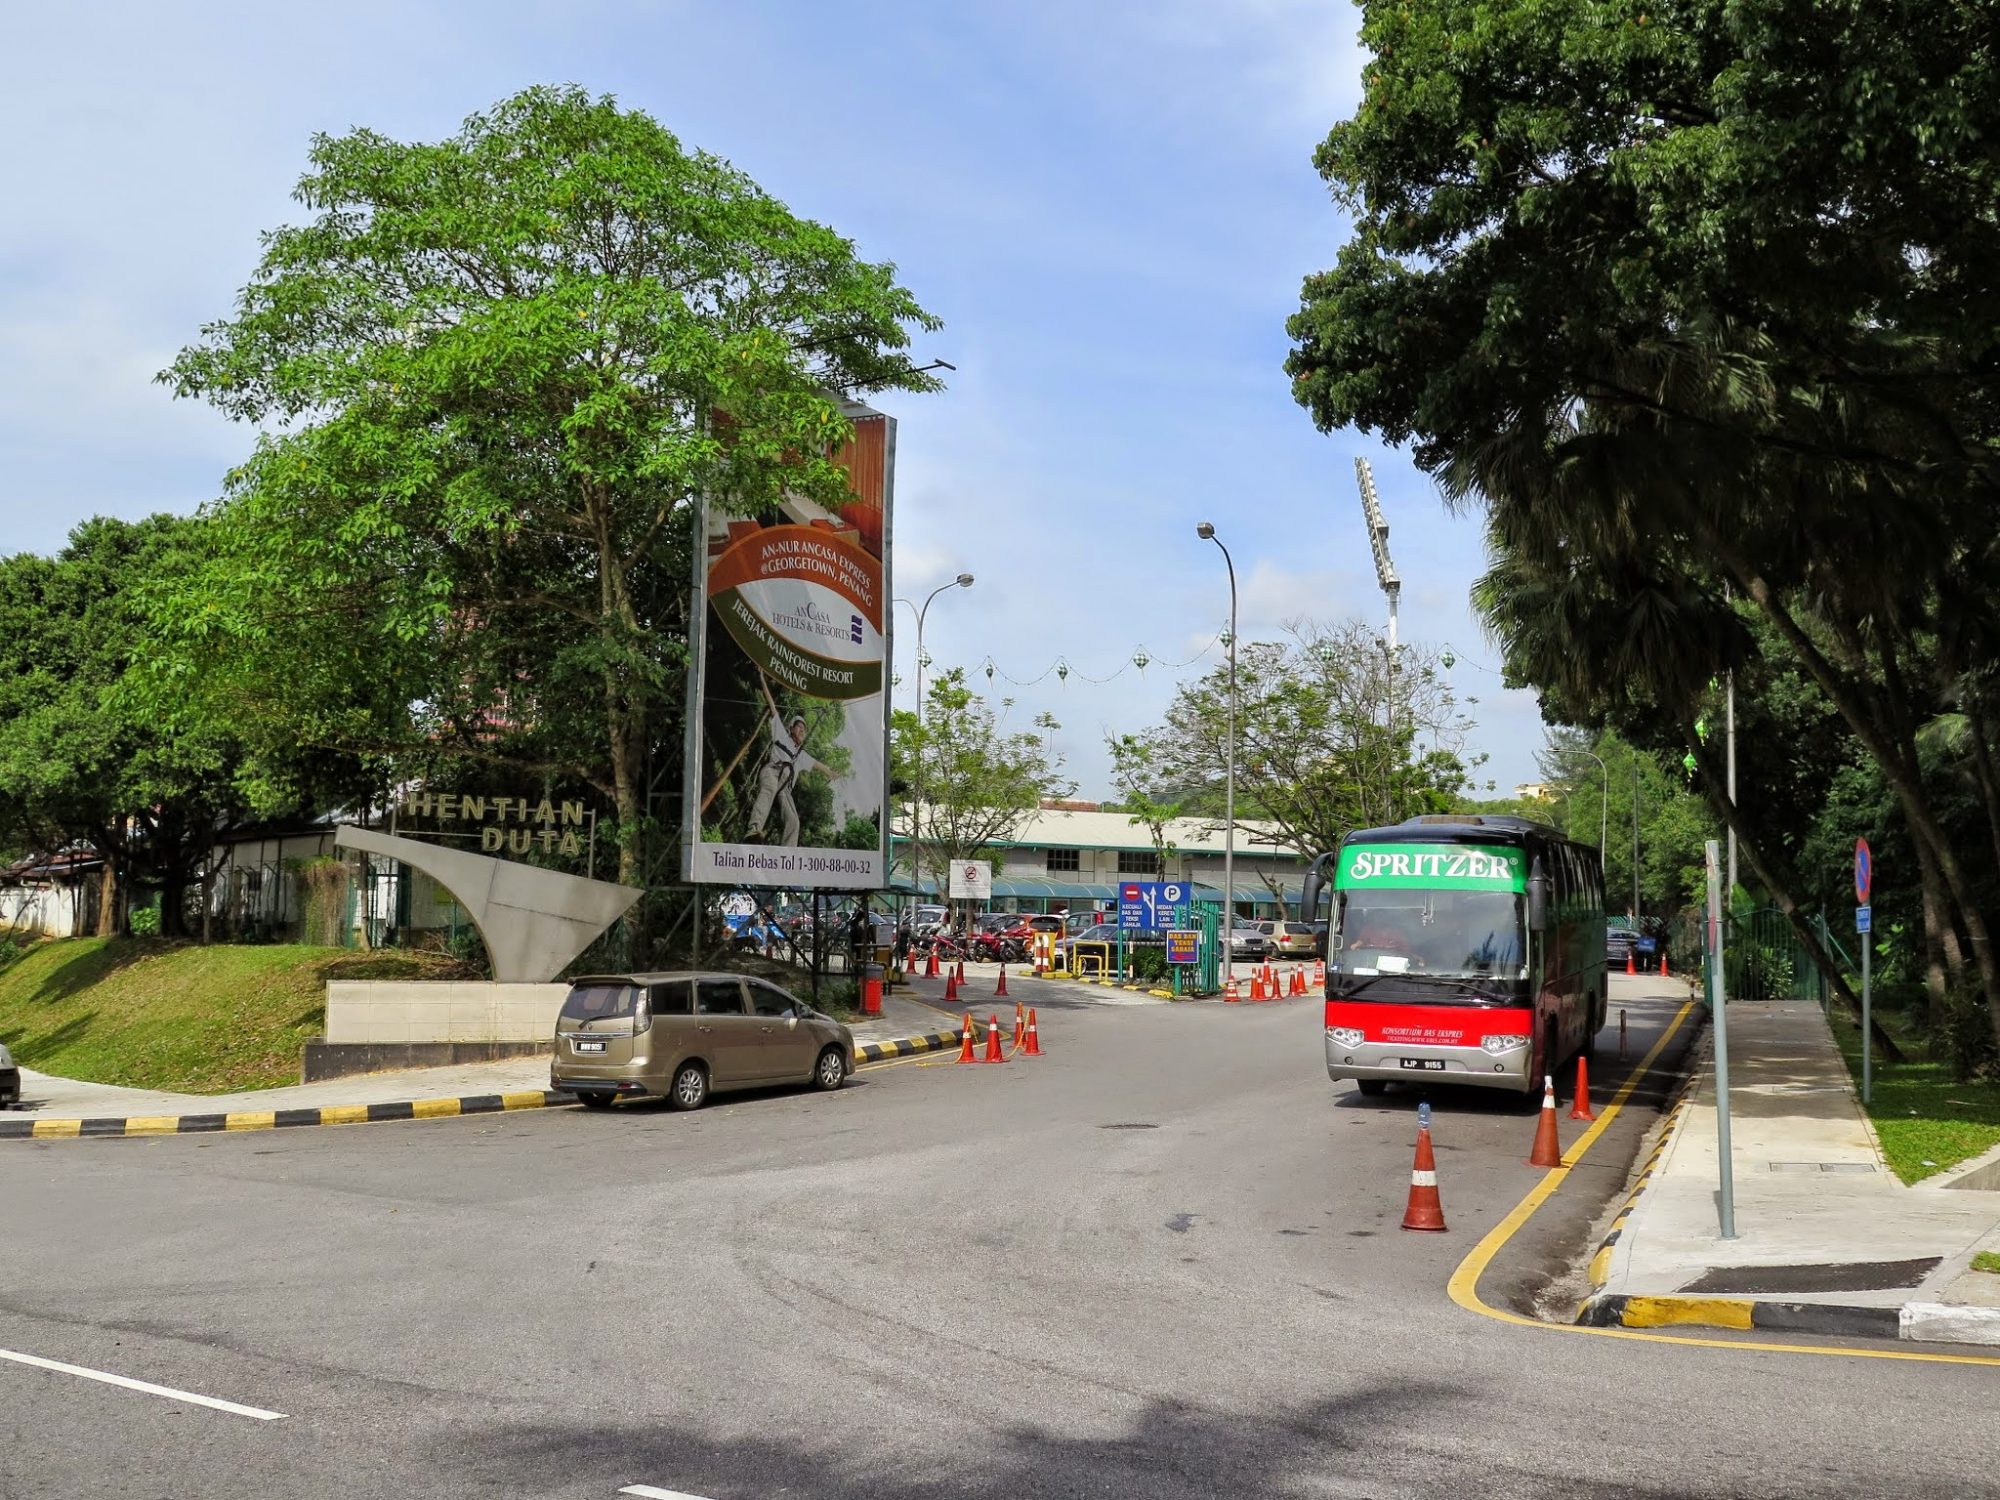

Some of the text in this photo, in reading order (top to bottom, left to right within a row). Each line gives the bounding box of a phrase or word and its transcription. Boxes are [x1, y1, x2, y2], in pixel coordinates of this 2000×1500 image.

[762, 541, 871, 589] AN-NUR ANCASA EXPRESS
[761, 557, 872, 607] @GEORGETOWN, PENANG
[731, 599, 854, 684] JEREJAK RAINFOREST RESORT
[772, 612, 806, 631] HOTELS
[815, 624, 850, 641] RESORTS
[769, 657, 808, 690] PENANG
[408, 791, 584, 825] HENTIAN
[482, 827, 580, 856] DUTA
[713, 851, 871, 874] Talian Bebas Tol 1-300-88-00-32
[1403, 1060, 1442, 1069] AJP 9155
